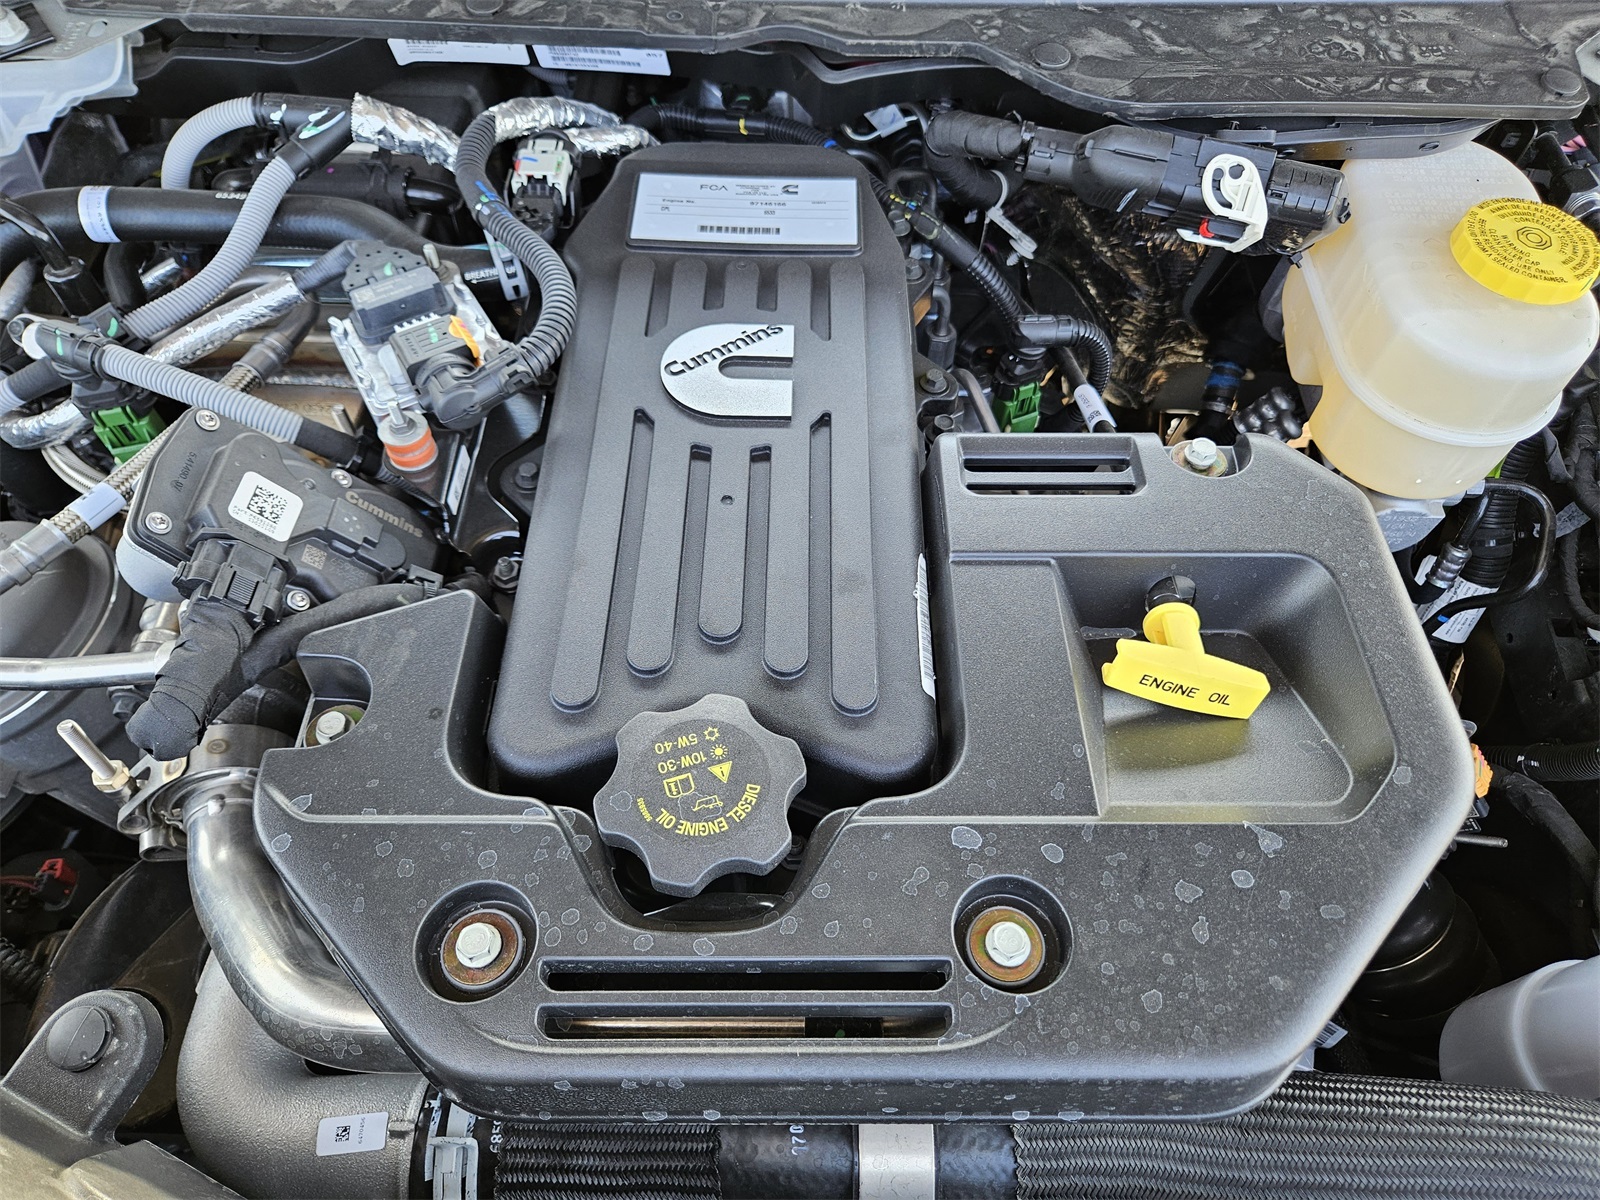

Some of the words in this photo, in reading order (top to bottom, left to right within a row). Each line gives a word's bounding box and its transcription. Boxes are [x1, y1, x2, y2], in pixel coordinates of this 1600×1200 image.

[663, 324, 784, 376] Cummins
[345, 490, 423, 538] Cummins
[1138, 674, 1200, 699] ENGINE
[1208, 692, 1231, 706] OIL
[654, 733, 699, 755] 5W-40
[657, 751, 707, 774] 10W-30
[726, 783, 761, 823] DIESEL
[655, 808, 677, 830] OIL
[675, 819, 729, 836] ENGINE
